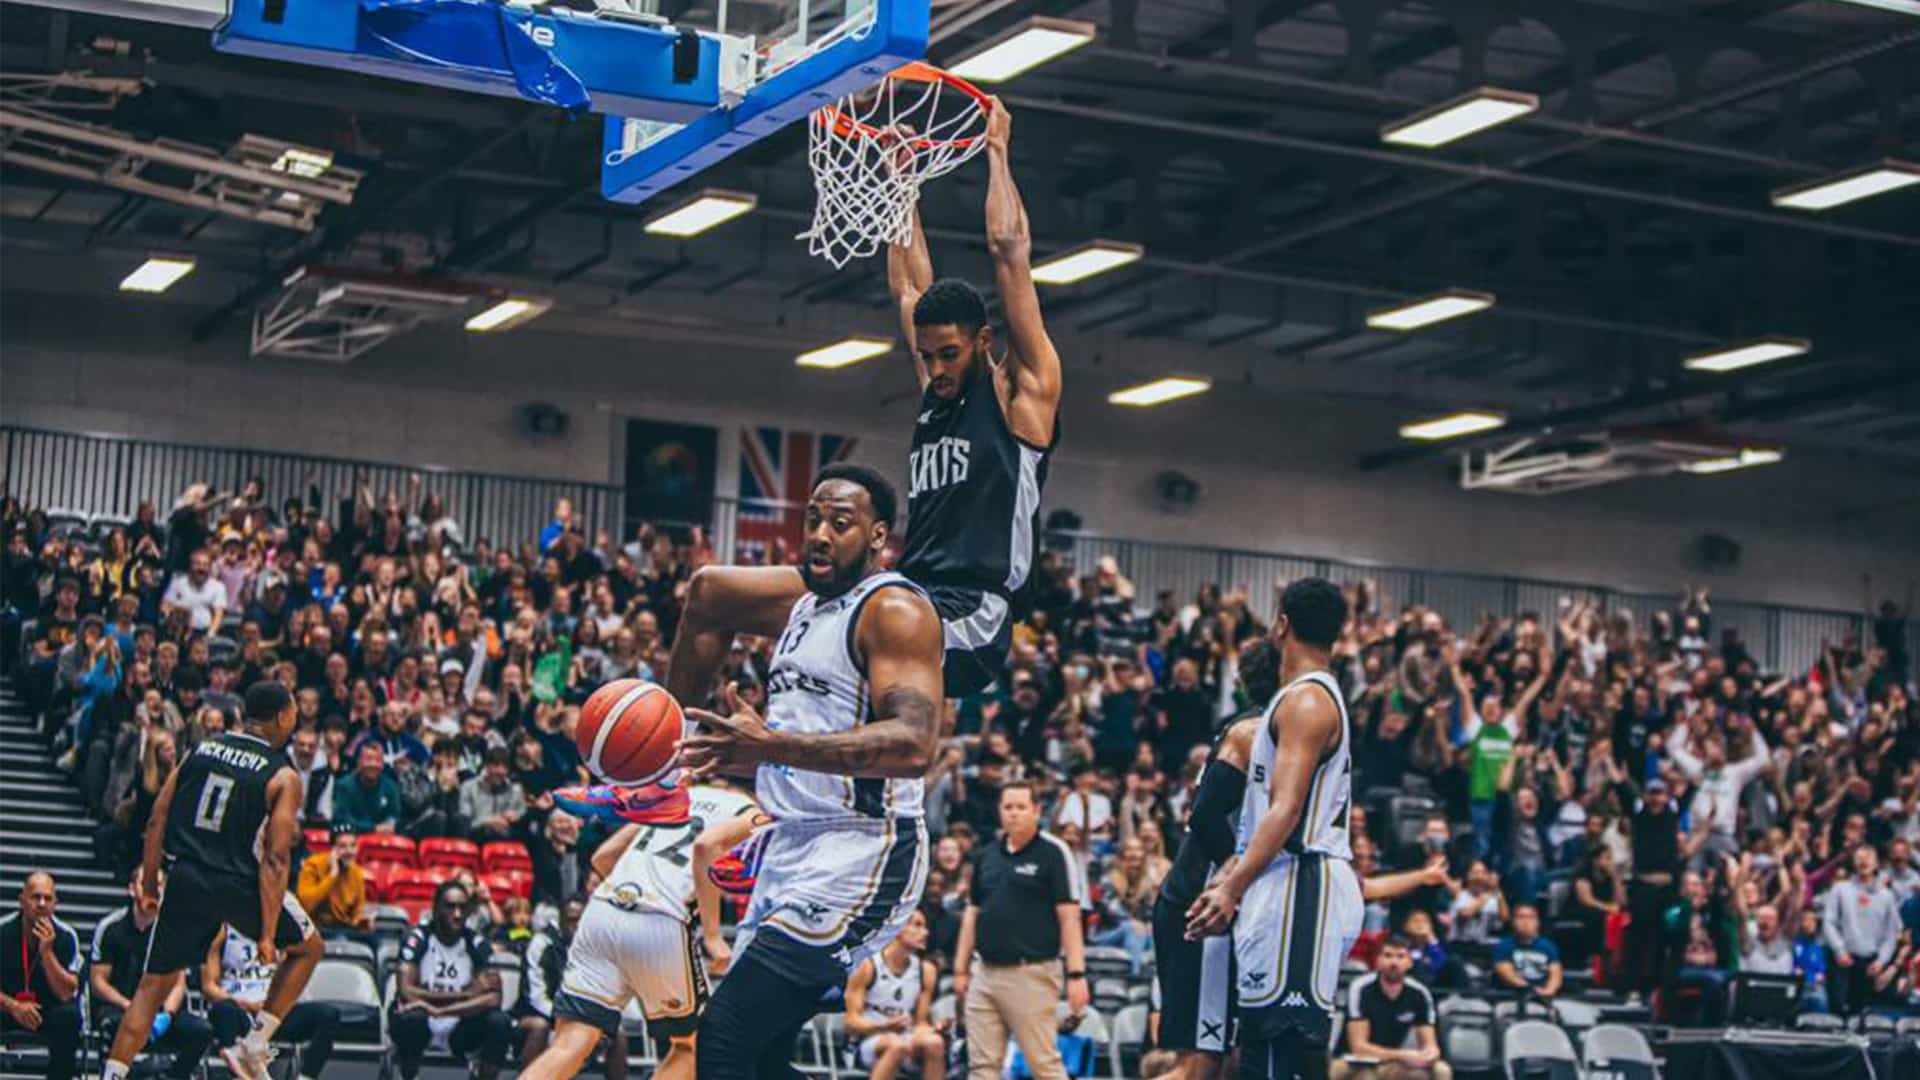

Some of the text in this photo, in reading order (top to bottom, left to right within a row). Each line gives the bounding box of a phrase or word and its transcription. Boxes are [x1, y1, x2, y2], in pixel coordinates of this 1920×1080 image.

[779, 620, 811, 656] 13
[194, 770, 236, 833] 0
[435, 961, 459, 978] 26
